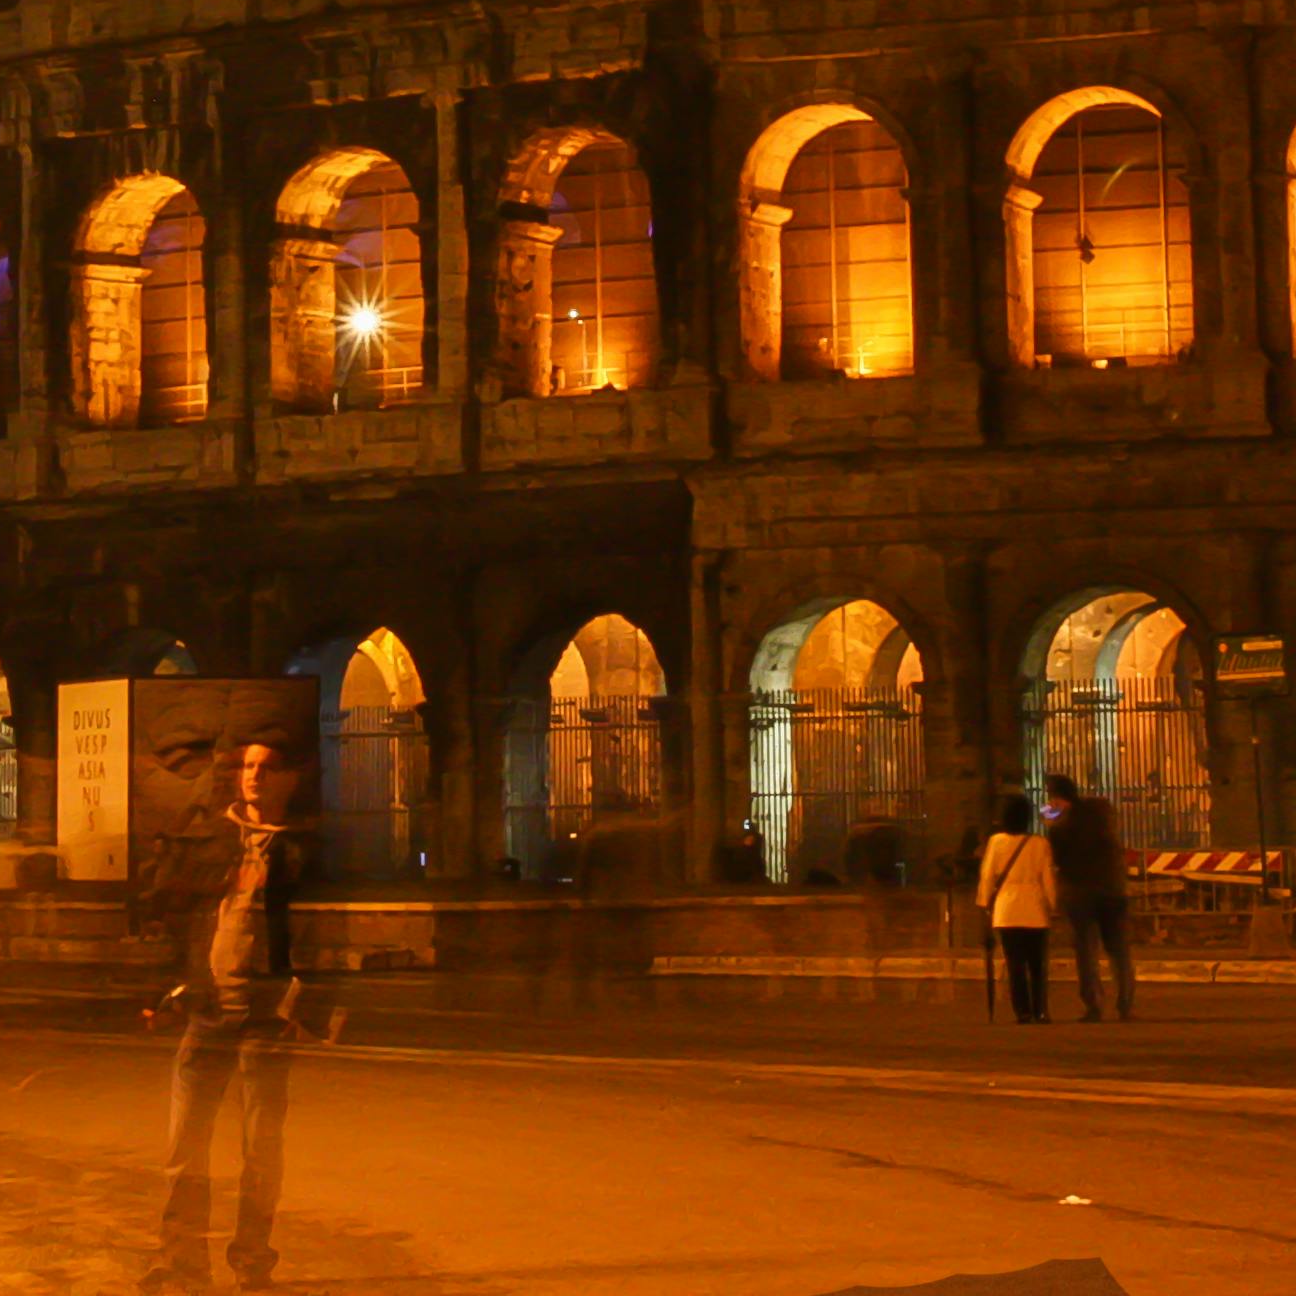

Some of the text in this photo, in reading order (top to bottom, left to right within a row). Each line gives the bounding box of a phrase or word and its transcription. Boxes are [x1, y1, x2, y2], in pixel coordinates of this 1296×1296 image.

[73, 708, 111, 730] DIVUS
[76, 734, 107, 755] VESP
[78, 760, 106, 780] ASIA
[82, 786, 101, 806] NU
